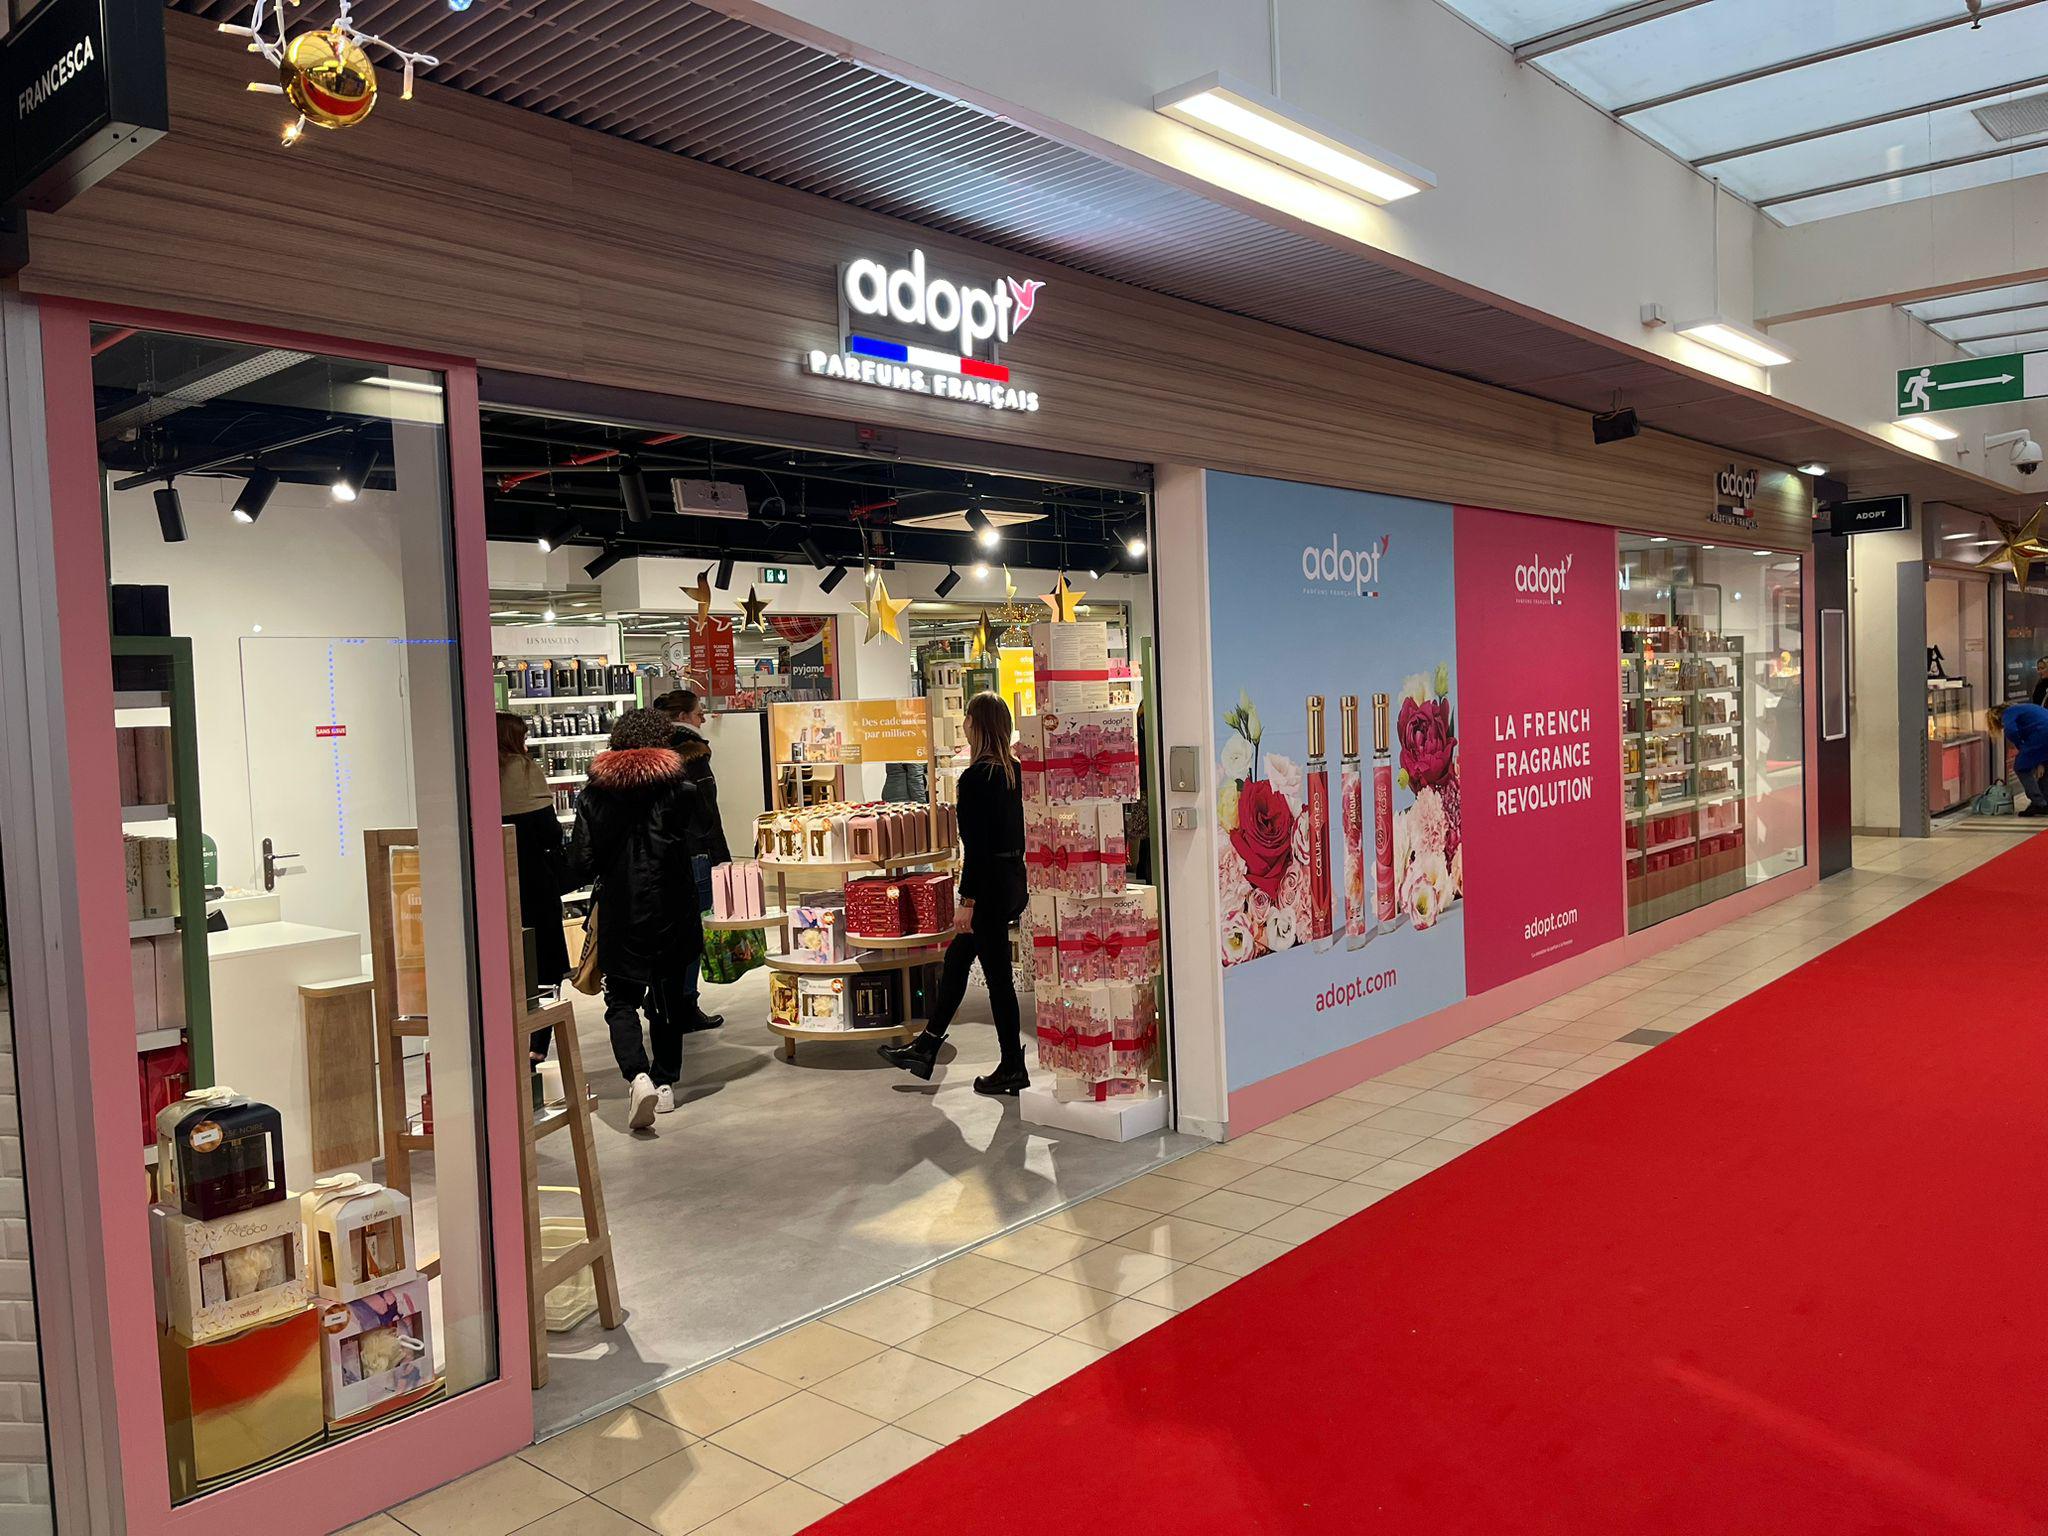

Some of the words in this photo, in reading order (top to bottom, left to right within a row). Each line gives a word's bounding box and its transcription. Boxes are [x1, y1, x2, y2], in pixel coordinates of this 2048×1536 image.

[18, 35, 94, 120] FRANCESCA
[845, 248, 1013, 357] adopt
[808, 350, 925, 391] PARFUMS
[933, 374, 1040, 412] FRANÇAIS
[1721, 464, 1755, 511] adopt
[1855, 510, 1886, 520] ADOPT
[1302, 533, 1379, 597] adopt
[1515, 553, 1567, 605] adopt
[792, 663, 825, 676] pyjama
[861, 717, 878, 727] Des
[879, 715, 917, 726] cadeaux
[864, 730, 880, 741] par
[881, 728, 917, 738] milliers
[1102, 717, 1123, 727] adopt
[1495, 715, 1517, 741] LA
[1523, 708, 1590, 738] FRENCH
[1495, 742, 1591, 779] FRAGRANCE
[1113, 901, 1134, 909] adopt
[1524, 908, 1578, 940] adopt.com
[1315, 968, 1397, 1013] adopt.com
